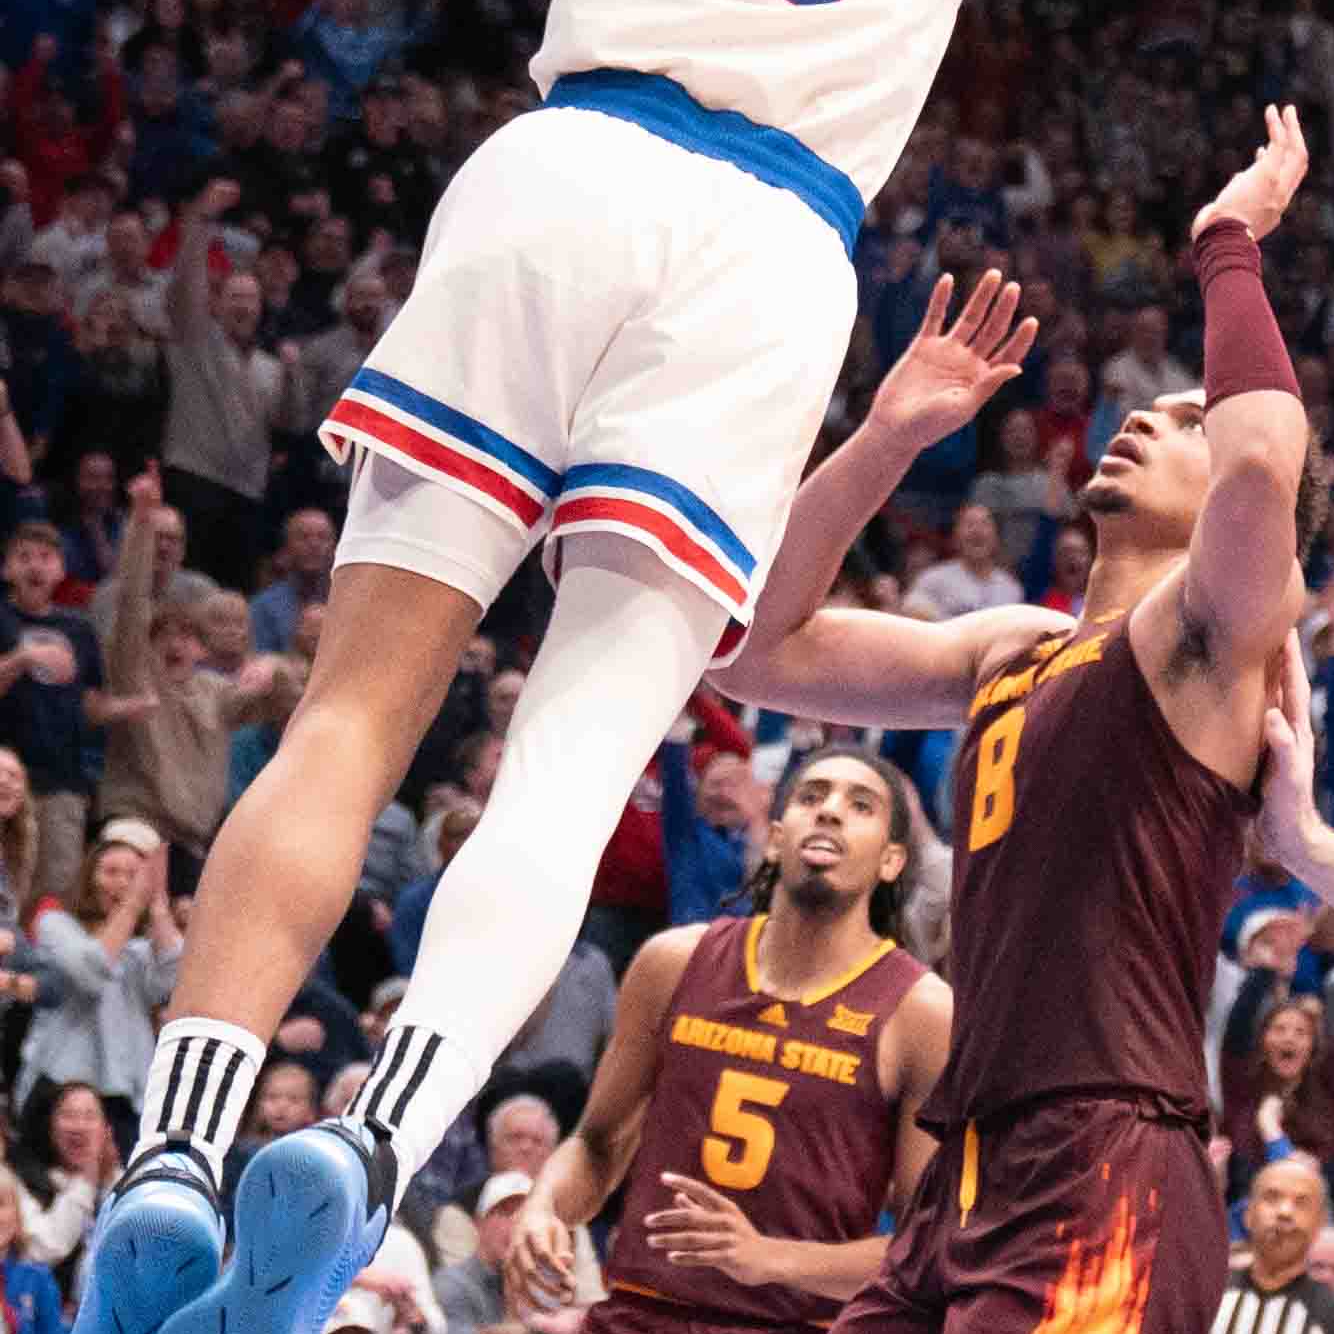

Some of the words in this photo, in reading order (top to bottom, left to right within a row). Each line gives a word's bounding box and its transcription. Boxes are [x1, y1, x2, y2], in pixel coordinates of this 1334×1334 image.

[671, 1014, 777, 1064] ARIZONA
[779, 1040, 861, 1085] STATE
[701, 1069, 790, 1190] 5
